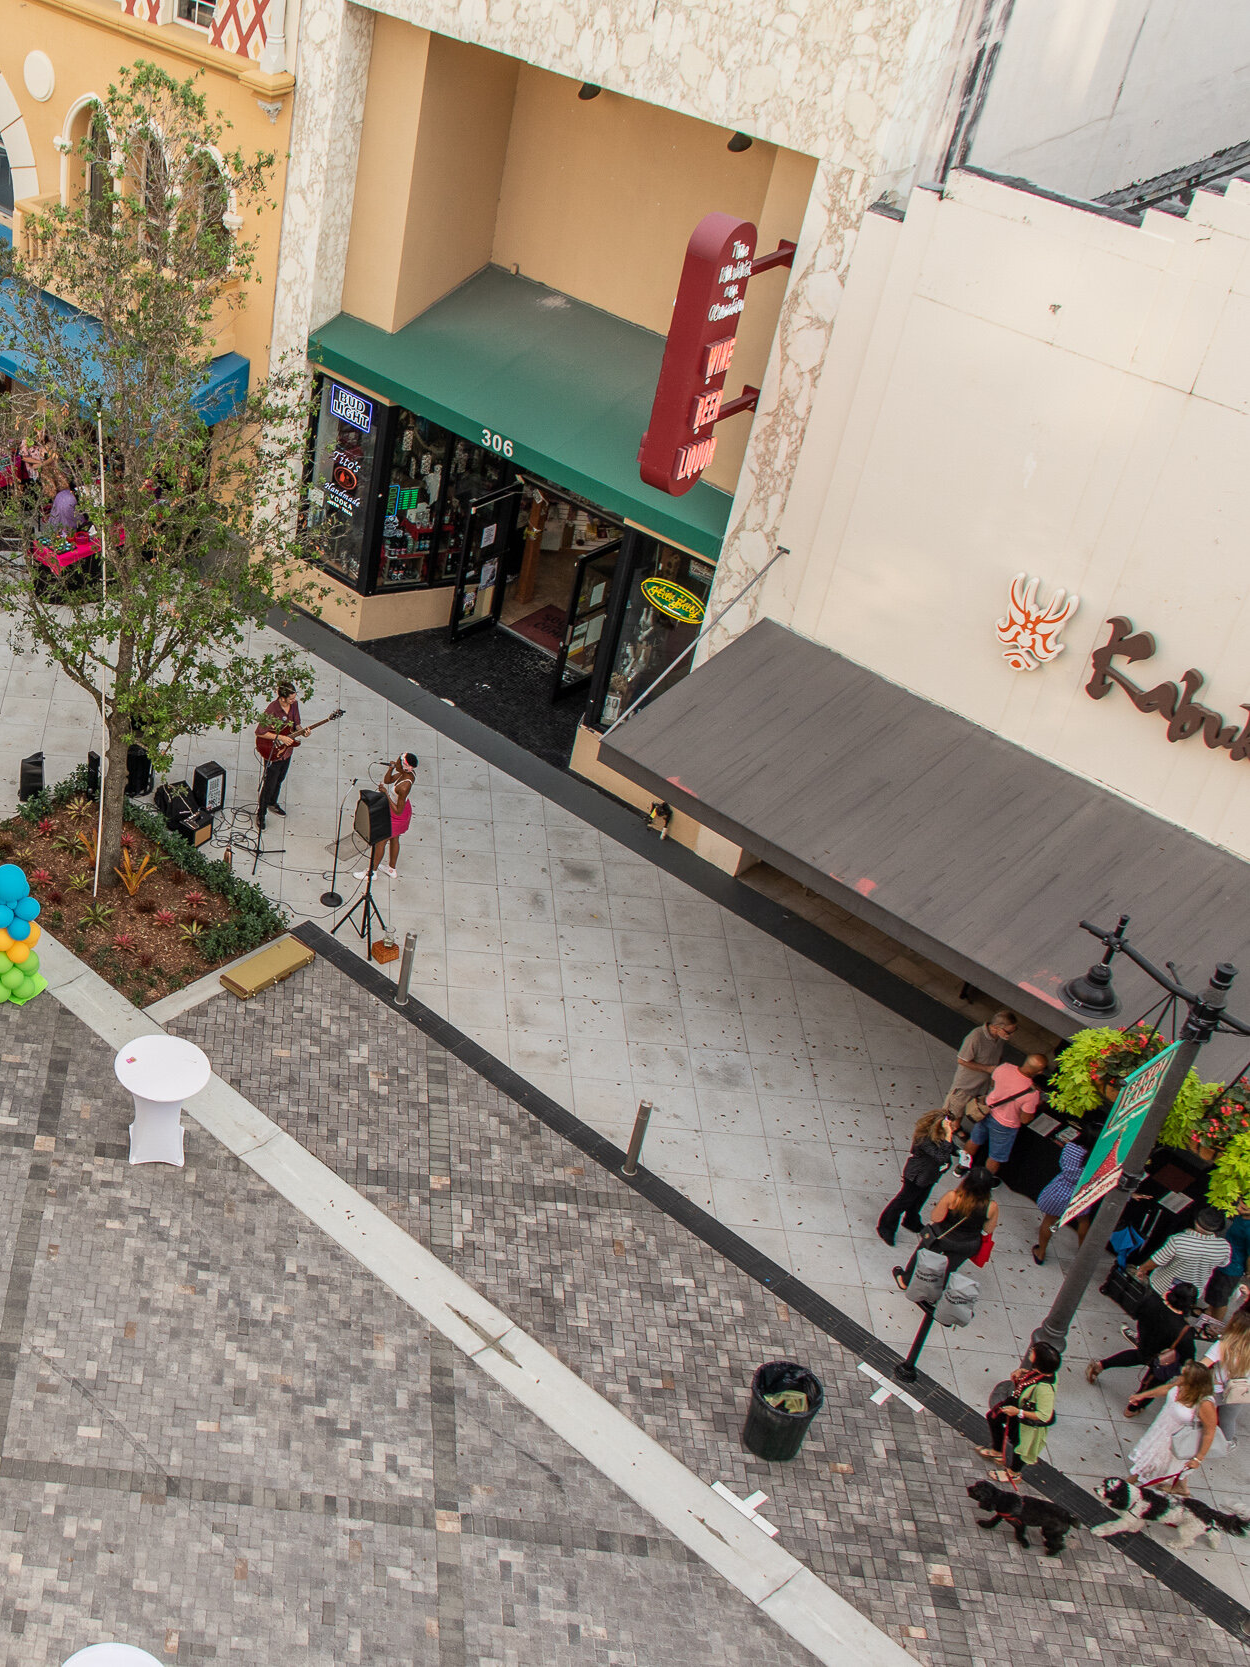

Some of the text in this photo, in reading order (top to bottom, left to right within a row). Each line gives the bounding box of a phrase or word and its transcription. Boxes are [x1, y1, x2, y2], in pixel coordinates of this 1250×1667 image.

[705, 337, 737, 379] WINE
[332, 400, 370, 429] LIGHT
[338, 389, 366, 414] BUD
[693, 389, 724, 429] BEER
[481, 428, 514, 458] 306
[332, 450, 362, 473] Tito's
[676, 436, 717, 480] LIQUOR
[324, 482, 361, 507] Handmade
[330, 493, 353, 511] VODKA
